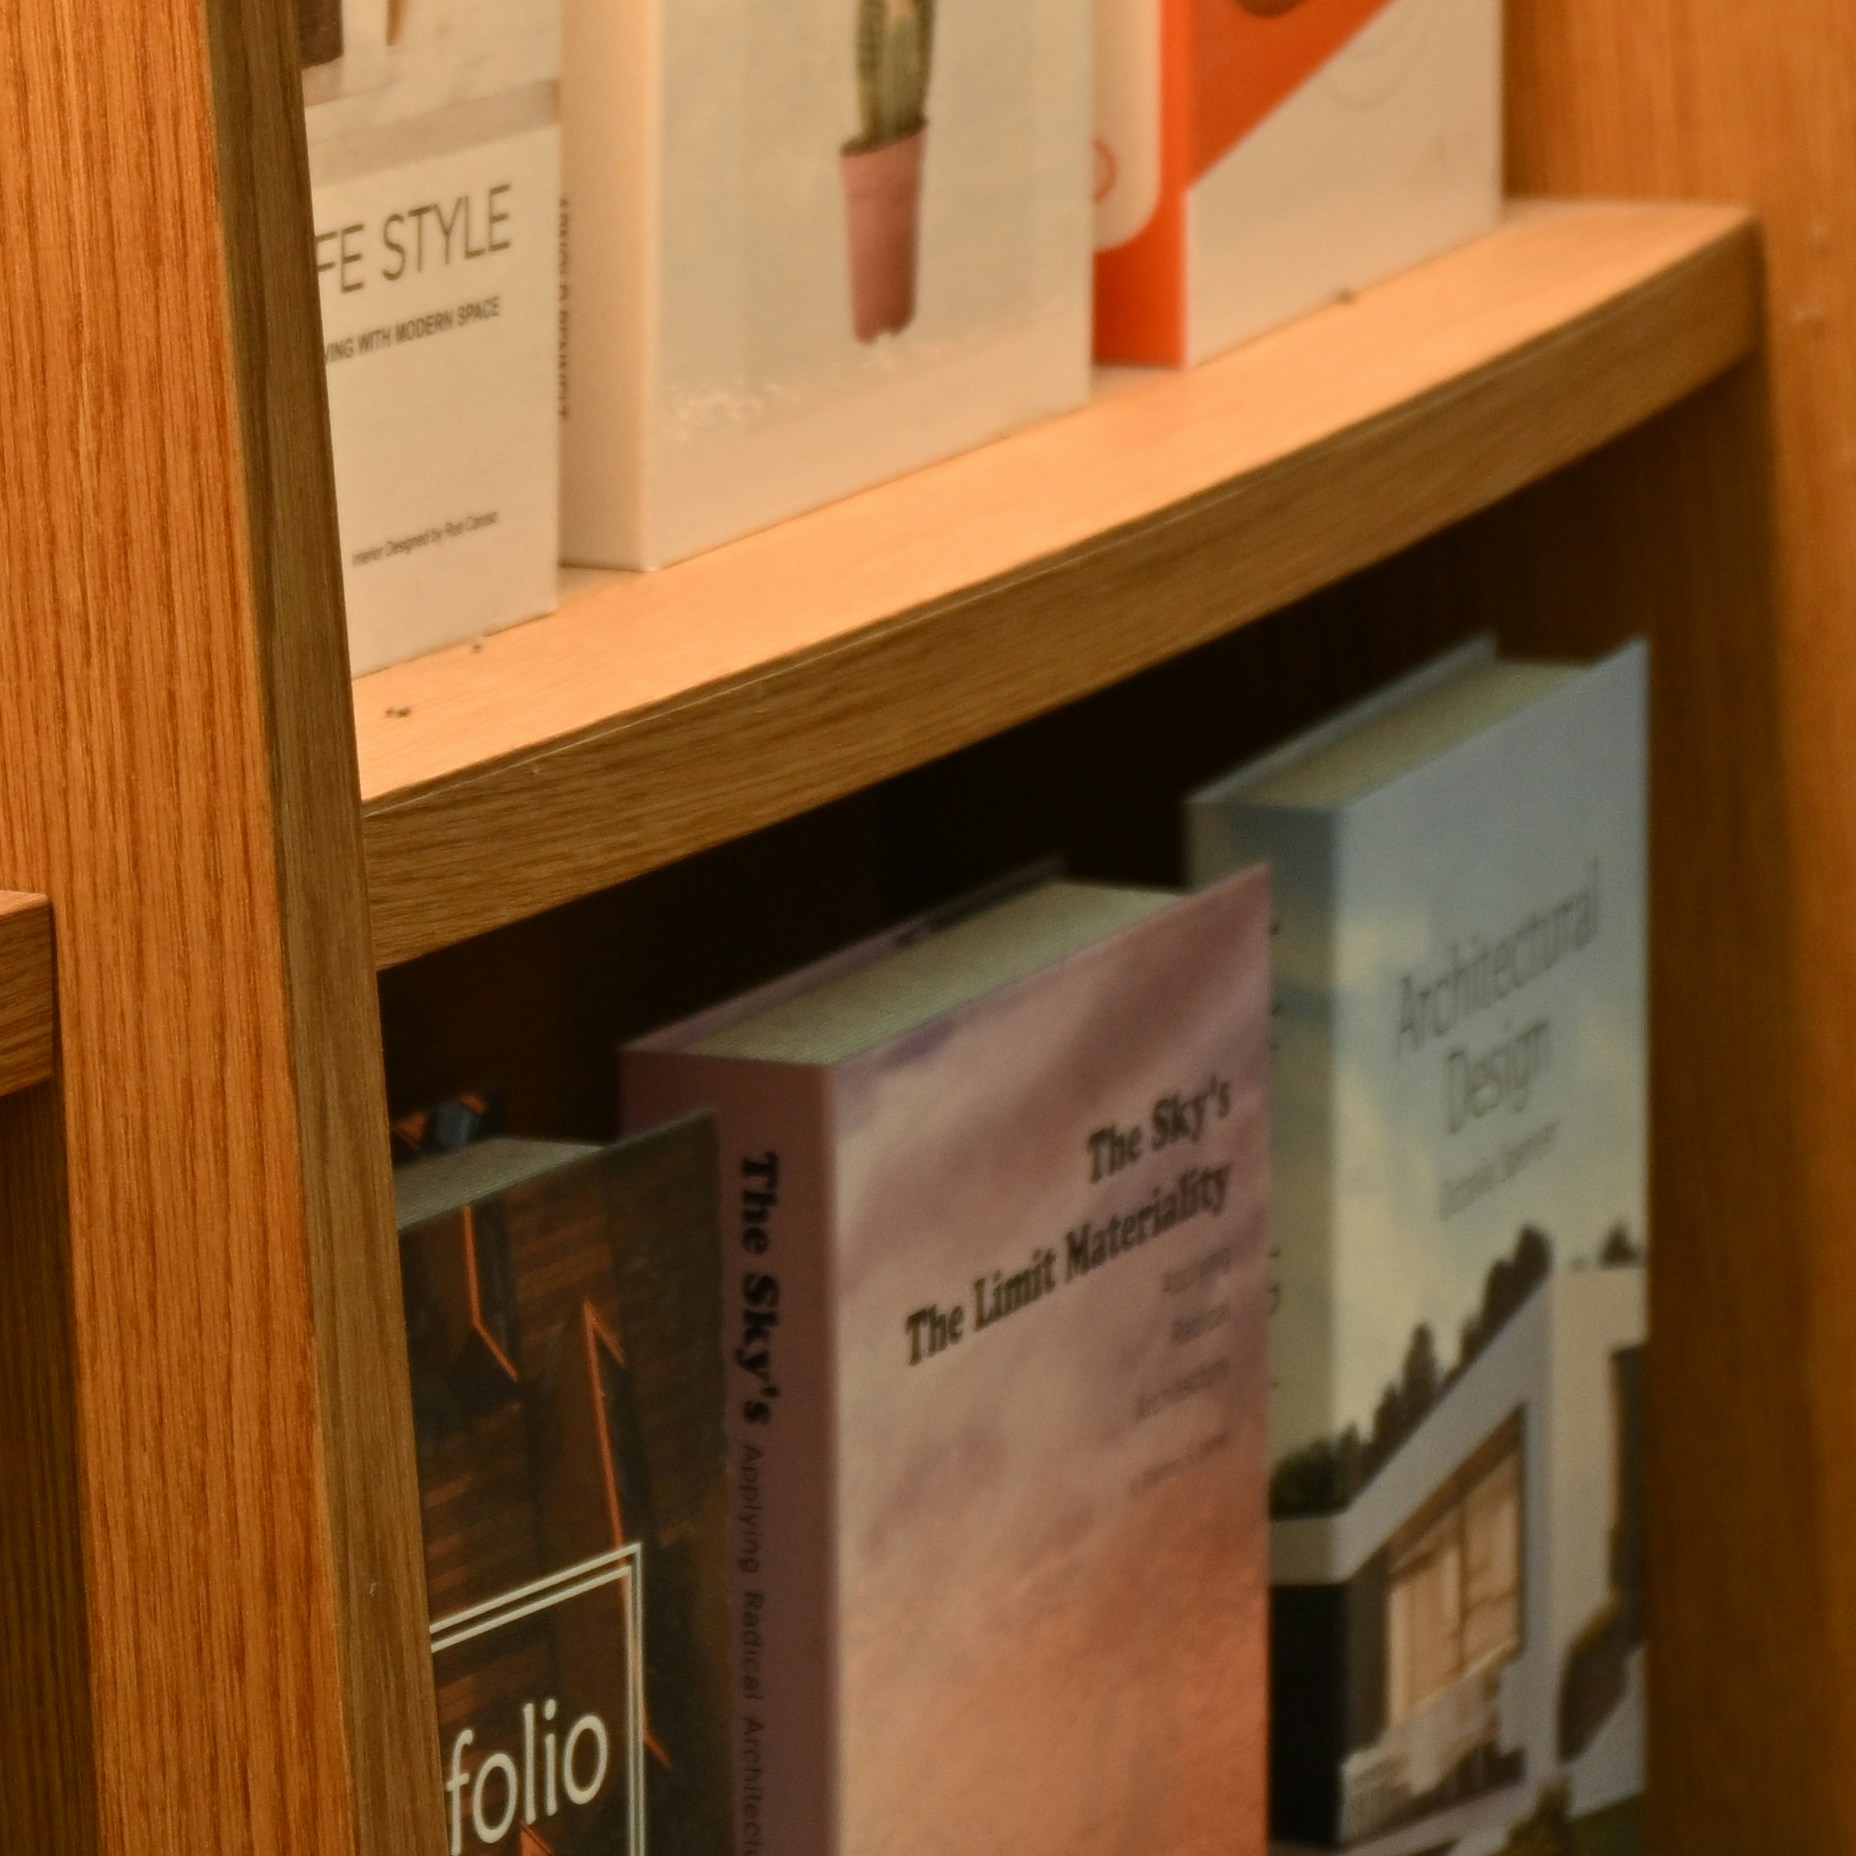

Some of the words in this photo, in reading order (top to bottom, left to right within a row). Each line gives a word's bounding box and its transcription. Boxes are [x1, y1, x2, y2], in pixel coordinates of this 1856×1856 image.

[382, 183, 510, 281] STYLE
[358, 326, 391, 354] WITH
[396, 310, 453, 342] MODERN
[457, 296, 500, 326] SPACE
[1087, 1122, 1140, 1185] The
[1152, 1075, 1231, 1154] Sky's
[741, 1153, 778, 1255] The
[906, 1296, 963, 1366] The
[973, 1249, 1056, 1332] Limit
[1066, 1159, 1231, 1277] Materiality
[735, 1274, 781, 1425] Sky's
[738, 1444, 762, 1574] Applying
[741, 1591, 763, 1700] Radical
[447, 1699, 608, 1856] folio
